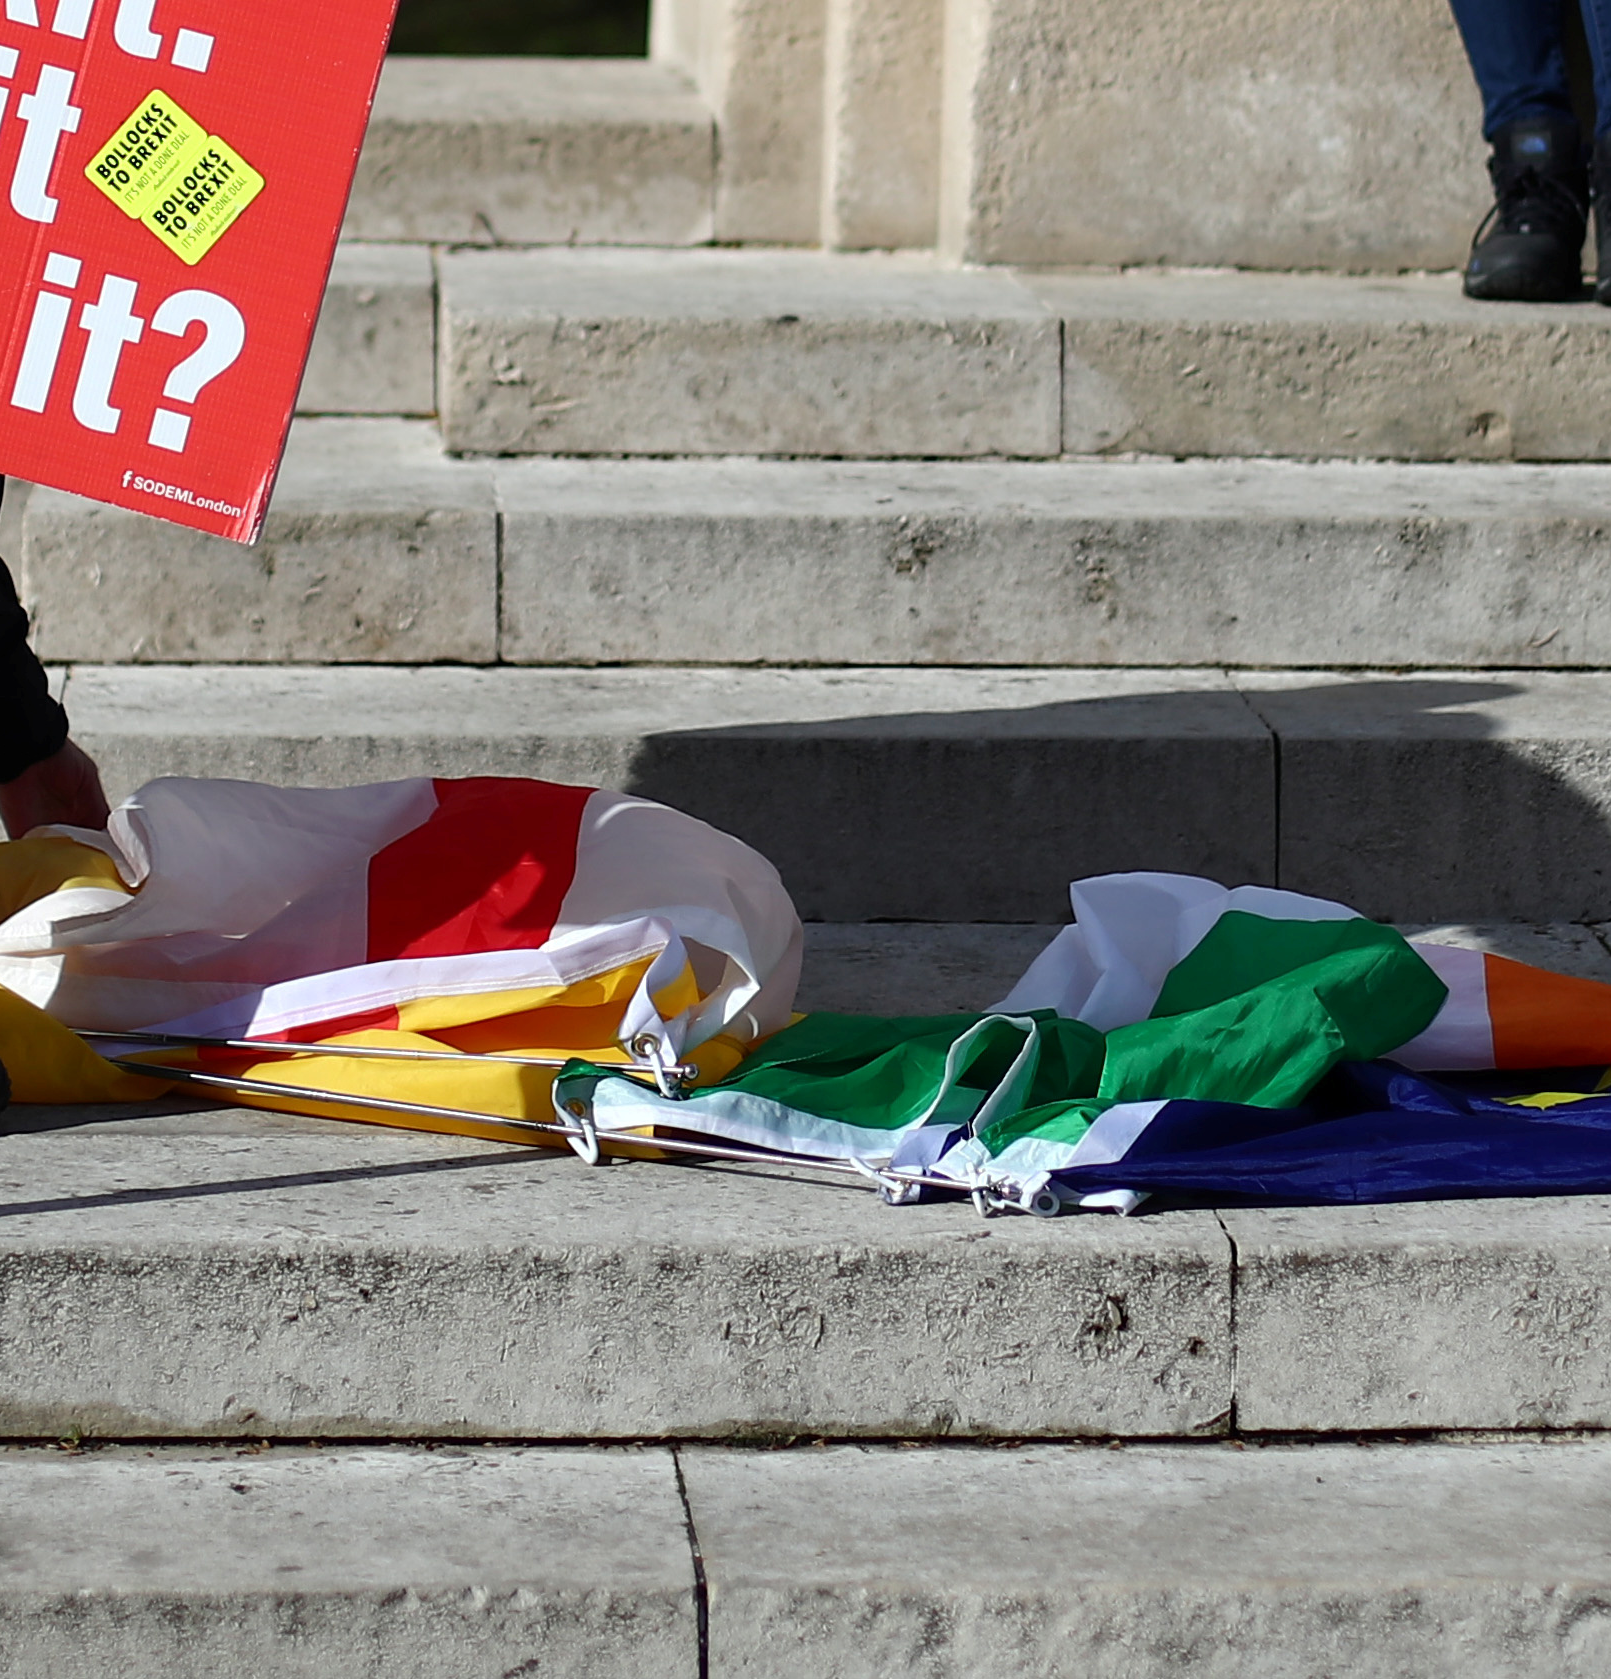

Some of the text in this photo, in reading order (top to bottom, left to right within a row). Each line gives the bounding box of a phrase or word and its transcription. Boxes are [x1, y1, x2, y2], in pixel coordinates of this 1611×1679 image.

[95, 103, 164, 179] BOLLOCKS
[107, 169, 130, 192] TO
[127, 113, 178, 170] BREXIT
[136, 171, 151, 191] NOT
[153, 148, 173, 170] DONE
[172, 130, 190, 150] DEAL
[152, 148, 221, 226] BOLLOCKS
[164, 216, 188, 238] TO
[185, 159, 235, 217] BREXIT
[192, 217, 207, 237] NOT
[211, 194, 231, 216] DONE
[229, 176, 247, 196] DEAL
[10, 252, 246, 453] it?
[133, 476, 241, 518] SODEMLondon
